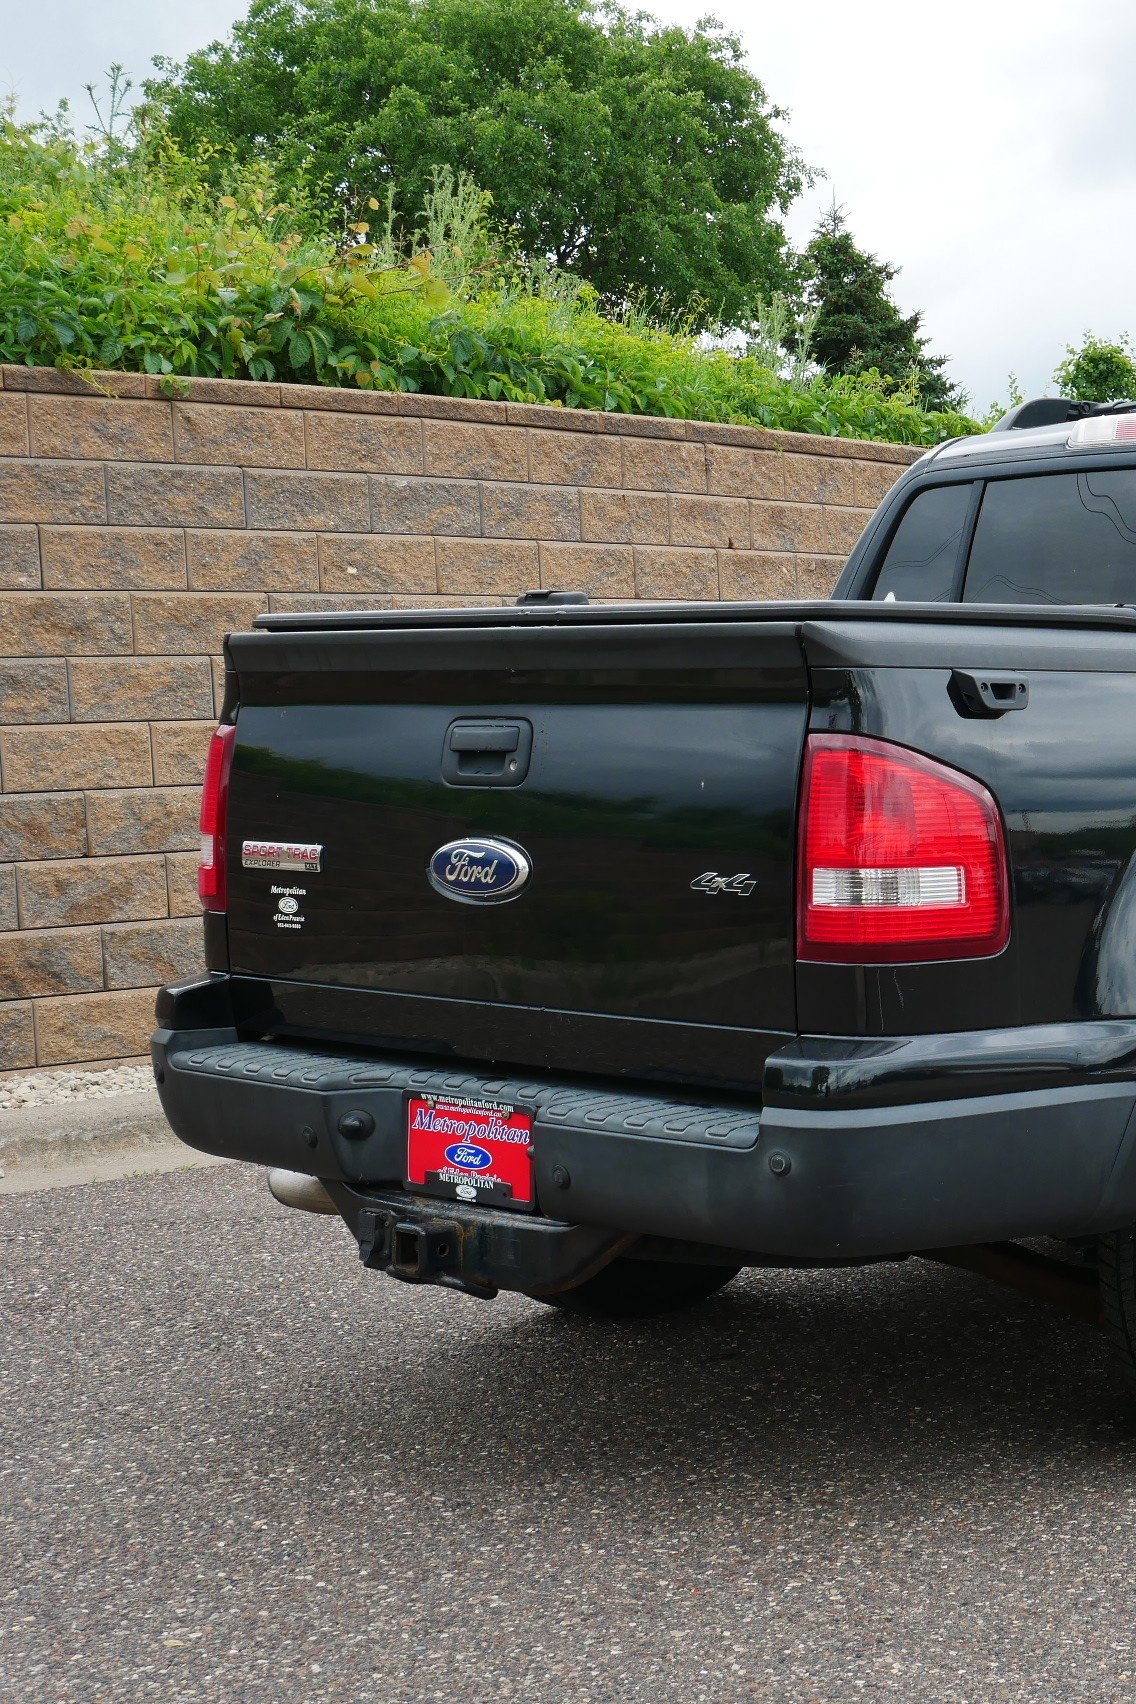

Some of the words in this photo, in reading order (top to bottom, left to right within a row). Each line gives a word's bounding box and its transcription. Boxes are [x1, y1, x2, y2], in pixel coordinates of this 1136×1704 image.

[243, 844, 284, 857] SPORT
[287, 847, 319, 861] TRAC
[244, 859, 281, 868] EXPLORER
[445, 849, 498, 884] Ford
[270, 885, 307, 896] Metropolitan
[420, 1093, 514, 1113] www.metropolitanford.com
[412, 1108, 530, 1144] Metropolitan
[454, 1147, 482, 1166] Ford
[439, 1173, 494, 1189] METROPOLITAN
